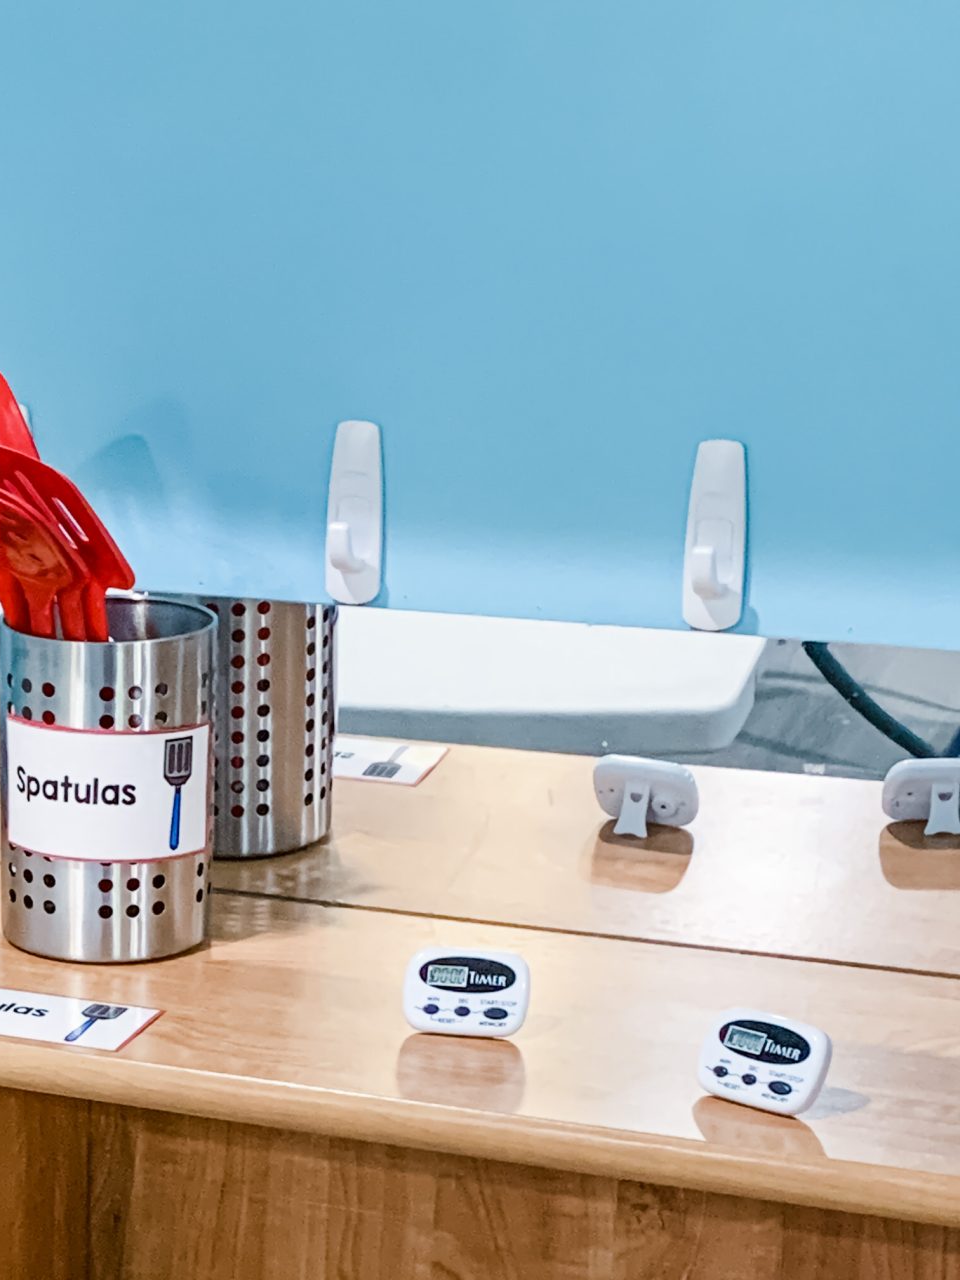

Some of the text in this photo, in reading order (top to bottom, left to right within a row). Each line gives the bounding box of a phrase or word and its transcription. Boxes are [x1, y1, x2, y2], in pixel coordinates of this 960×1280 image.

[16, 765, 136, 806] Spatulas
[468, 970, 507, 987] TIMER
[764, 1038, 801, 1061] TIMER
